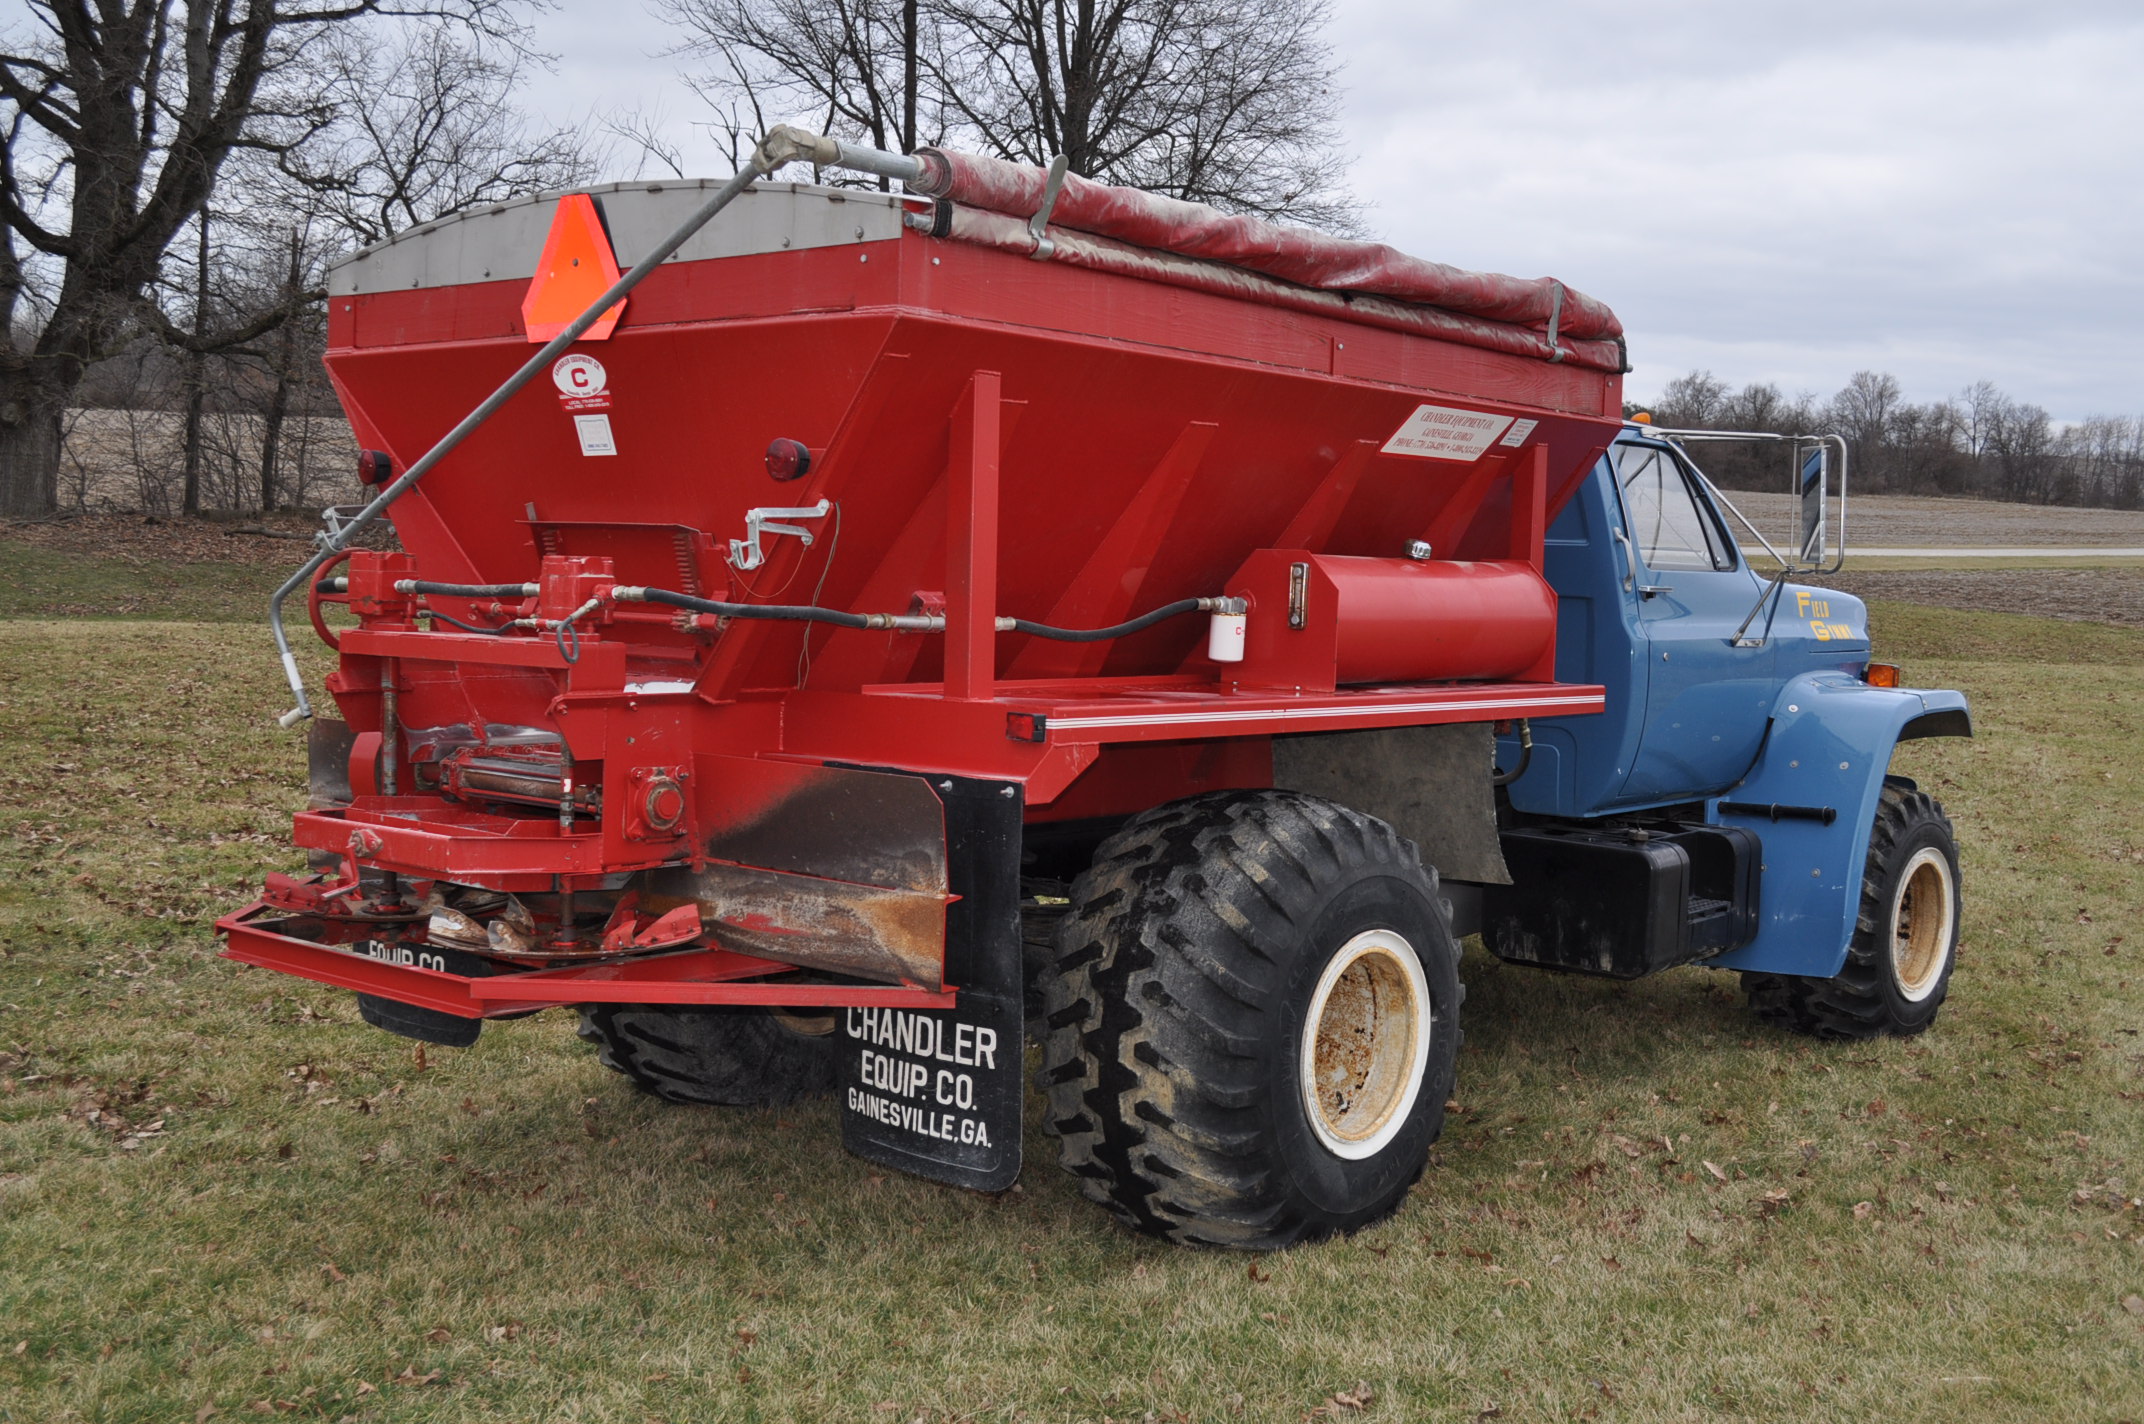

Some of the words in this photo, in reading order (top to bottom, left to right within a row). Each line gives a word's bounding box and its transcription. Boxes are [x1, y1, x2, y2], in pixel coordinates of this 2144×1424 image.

[571, 367, 589, 388] C
[1421, 411, 1454, 425] CHANDLER
[1450, 415, 1487, 428] EQUIPMENT
[846, 1006, 998, 1070] CHANDLER
[861, 1049, 928, 1101] EQUIP.
[935, 1069, 978, 1111] CO.
